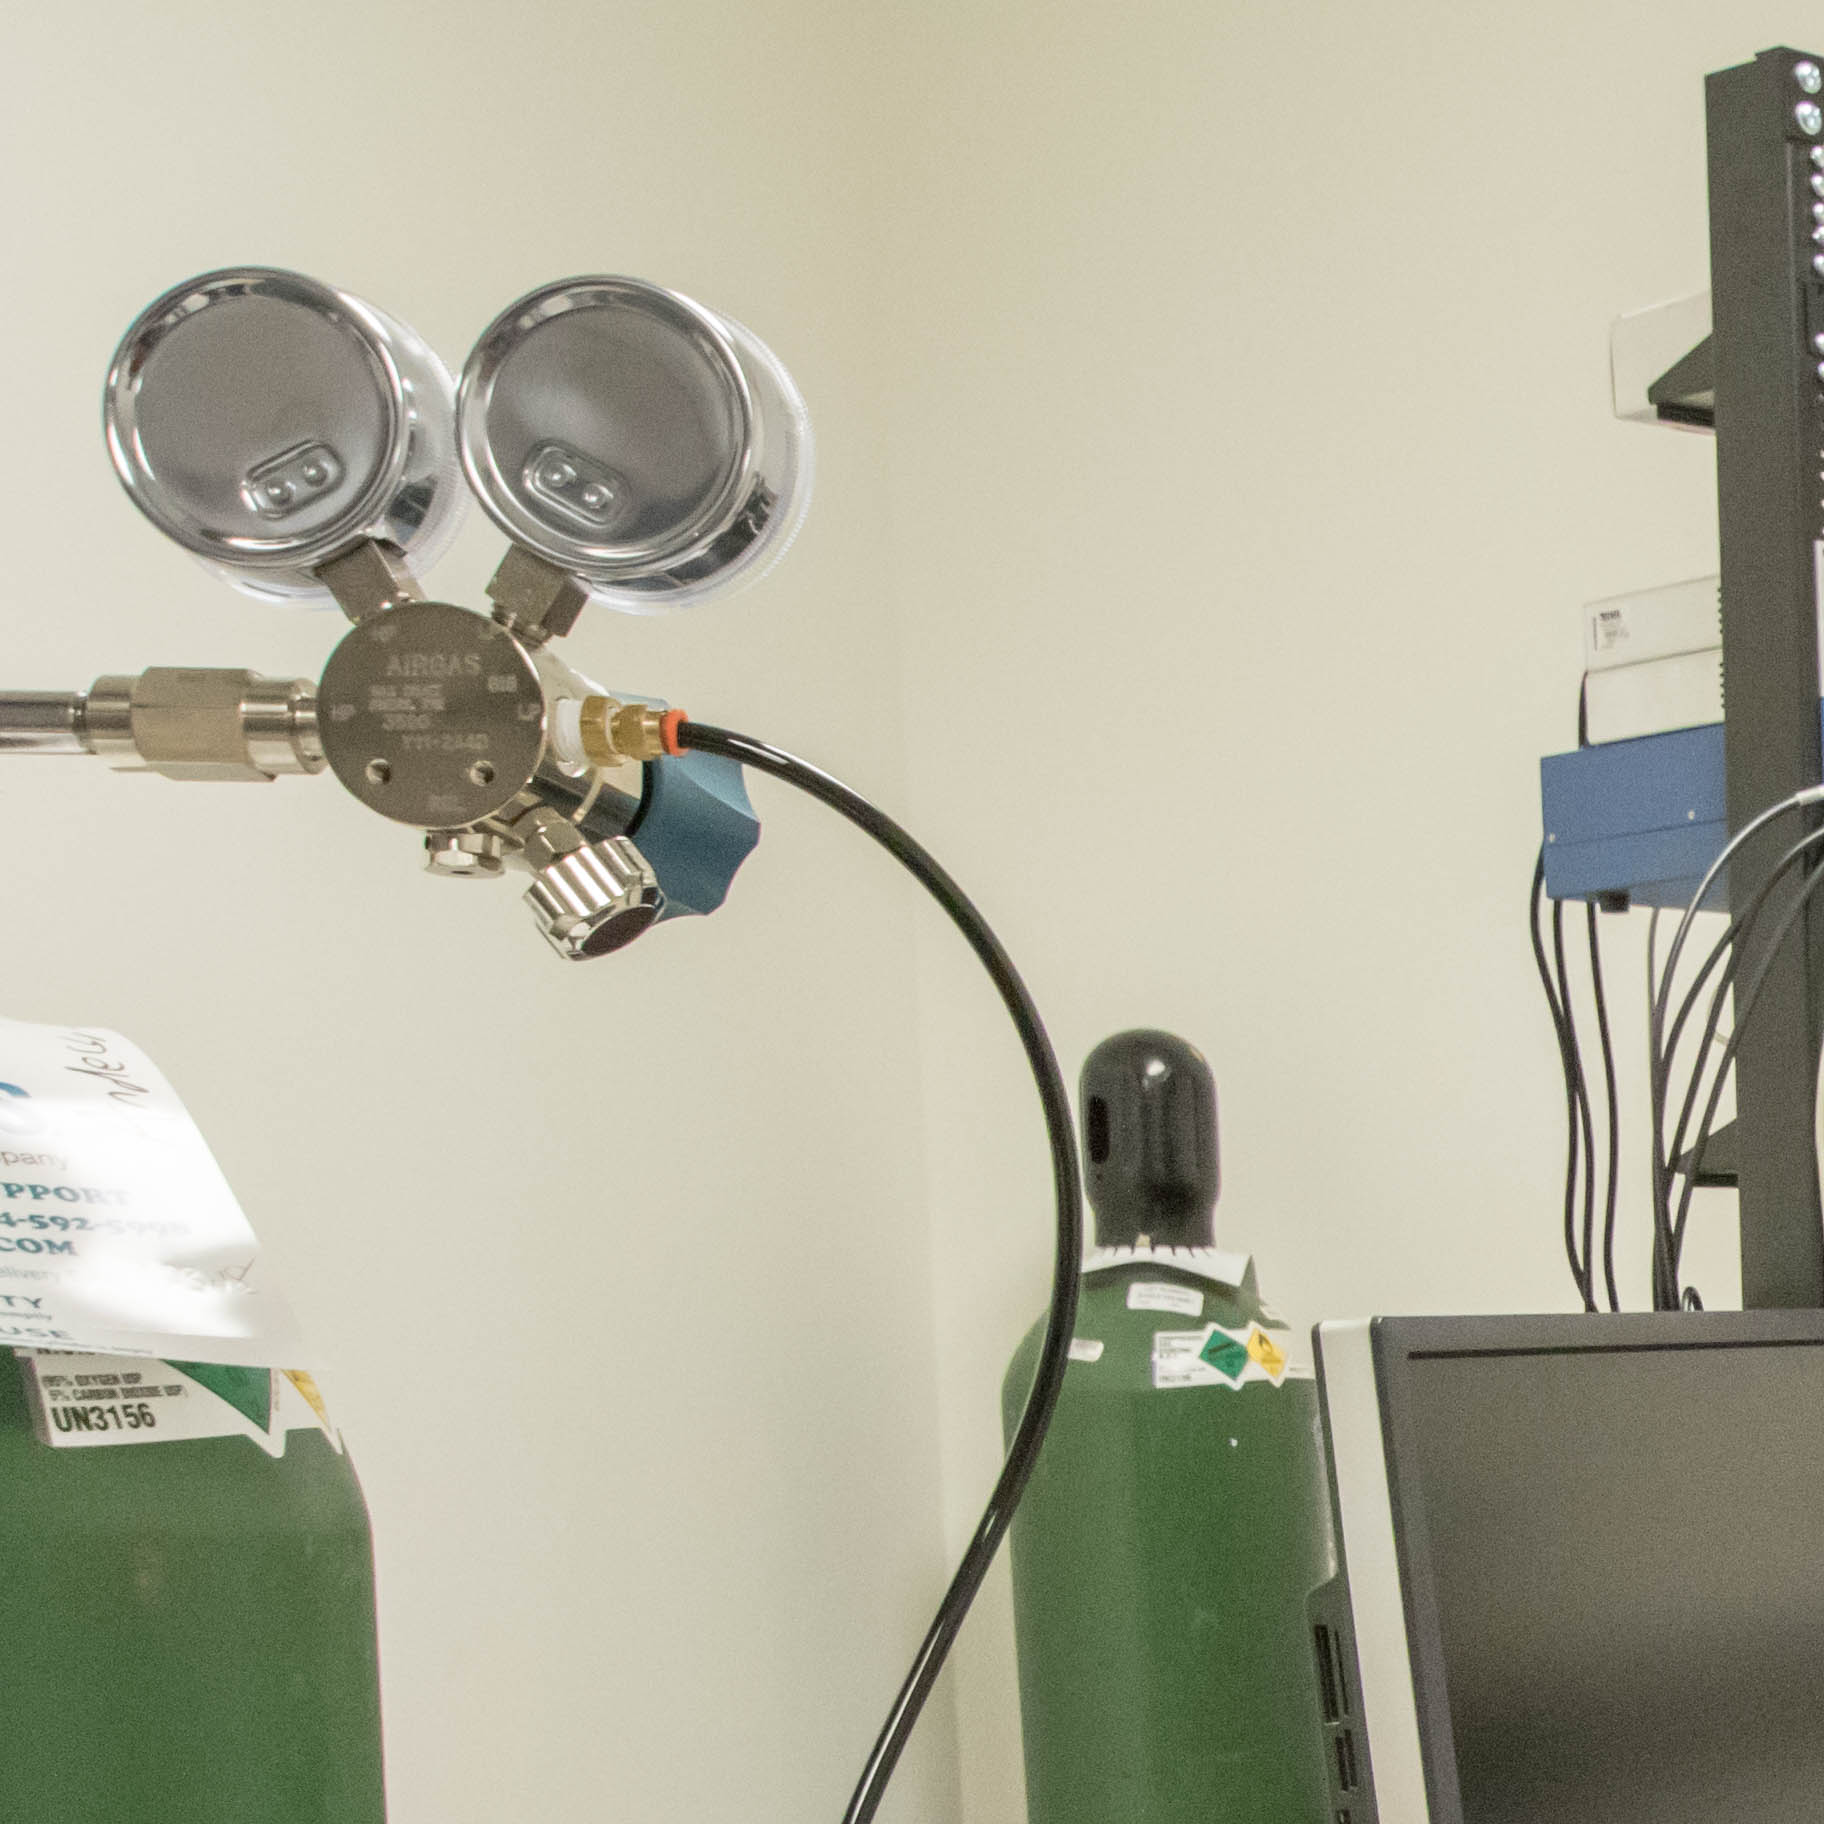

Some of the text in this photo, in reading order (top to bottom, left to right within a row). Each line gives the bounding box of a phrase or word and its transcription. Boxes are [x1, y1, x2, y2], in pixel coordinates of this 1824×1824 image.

[386, 653, 481, 676] AIRGAS
[75, 1373, 120, 1387] OXYGEN
[72, 1388, 120, 1401] CARBON
[51, 1403, 156, 1432] UN3156
